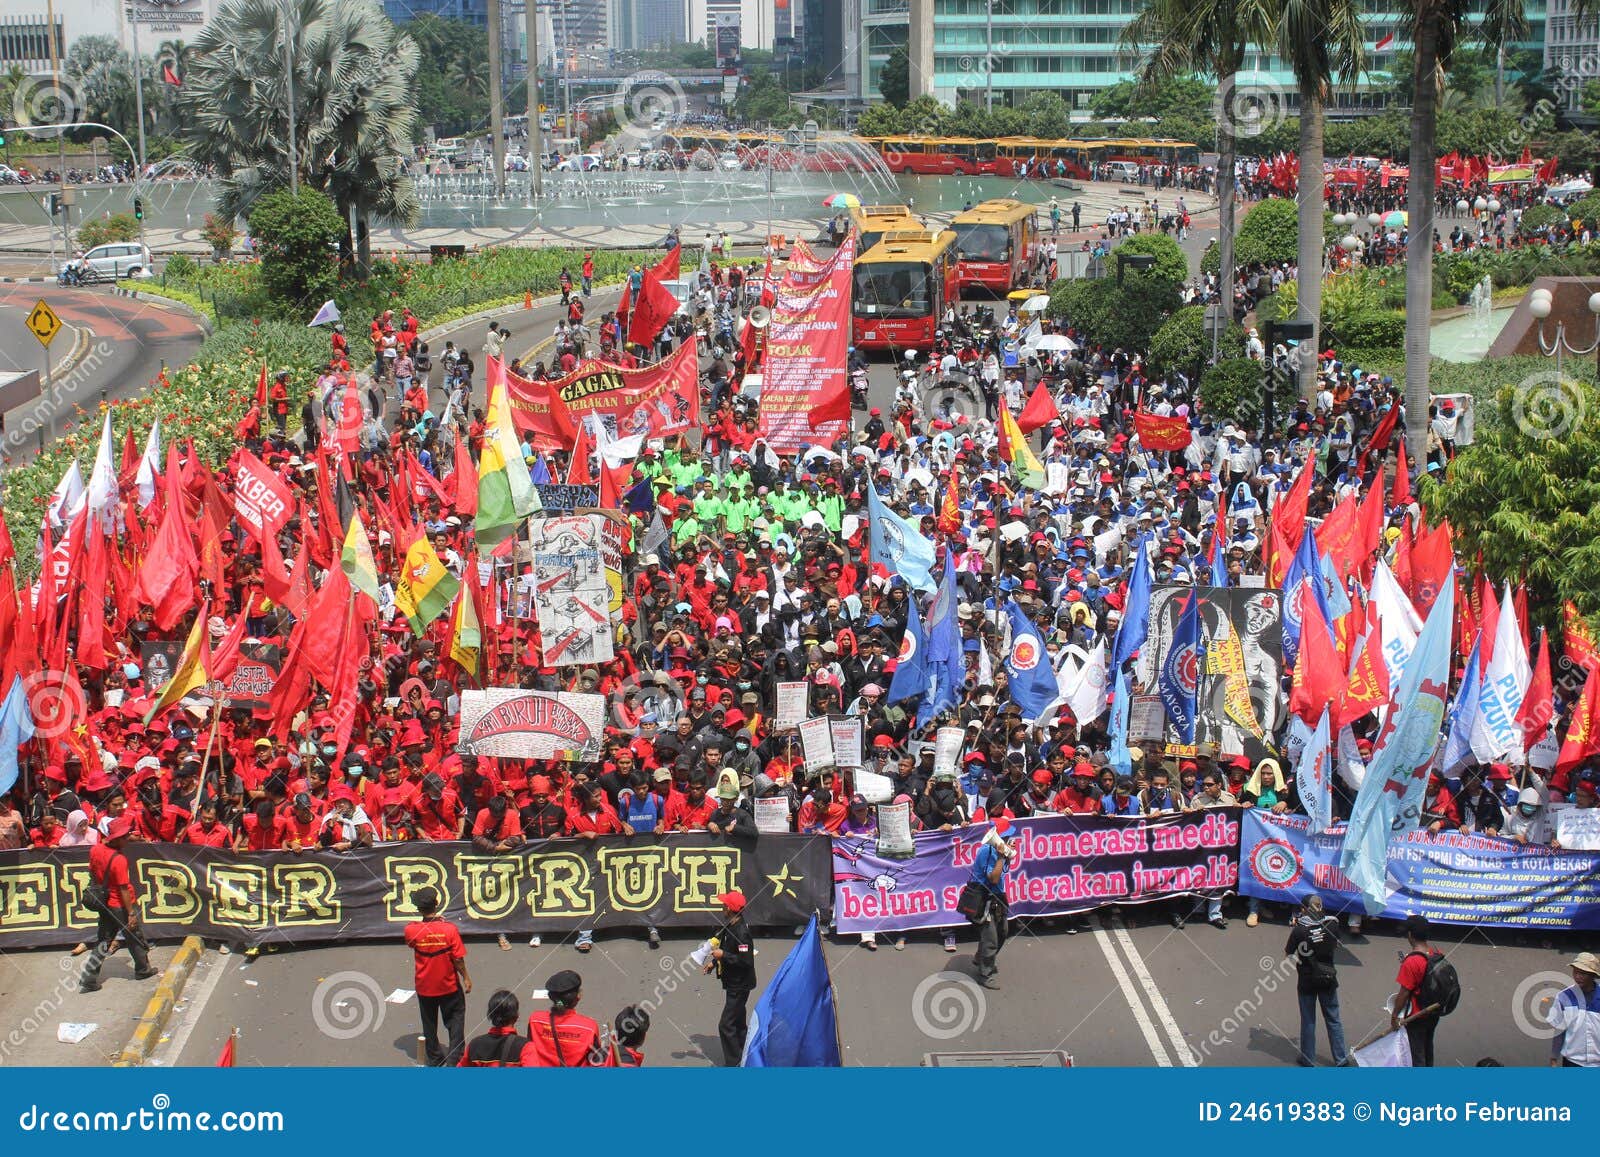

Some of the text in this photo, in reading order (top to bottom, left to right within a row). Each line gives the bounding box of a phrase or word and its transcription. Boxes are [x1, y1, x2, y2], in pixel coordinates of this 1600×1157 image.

[559, 373, 624, 402] GAGAL
[1160, 682, 1190, 731] MAYORA
[1480, 674, 1514, 743] UZUKI
[1497, 672, 1522, 717] PUK
[500, 697, 549, 727] BURUH
[551, 704, 583, 729] BUKAN
[551, 719, 584, 740] BUDAK
[1154, 811, 1239, 851] media
[1407, 848, 1425, 862] FSP
[1428, 850, 1453, 866] PPMI
[1455, 853, 1479, 868] SPSI
[1522, 857, 1551, 871] KOTA
[1553, 857, 1592, 872] BEKASI
[1422, 866, 1449, 877] HAPUS
[1483, 872, 1510, 881] KERJA
[1511, 874, 1551, 882] KONTRAK
[383, 846, 744, 922] BURUH
[1422, 879, 1469, 890] WUJUDKAN
[1470, 882, 1493, 891] UPAH
[1494, 884, 1519, 893] LAYAK
[841, 884, 937, 919] belum
[1476, 904, 1494, 912] PRO
[1425, 911, 1443, 919] MEI
[1444, 913, 1480, 921] SEBAGAI
[1502, 916, 1529, 924] LIBUR
[1529, 916, 1572, 926] NASIONAL
